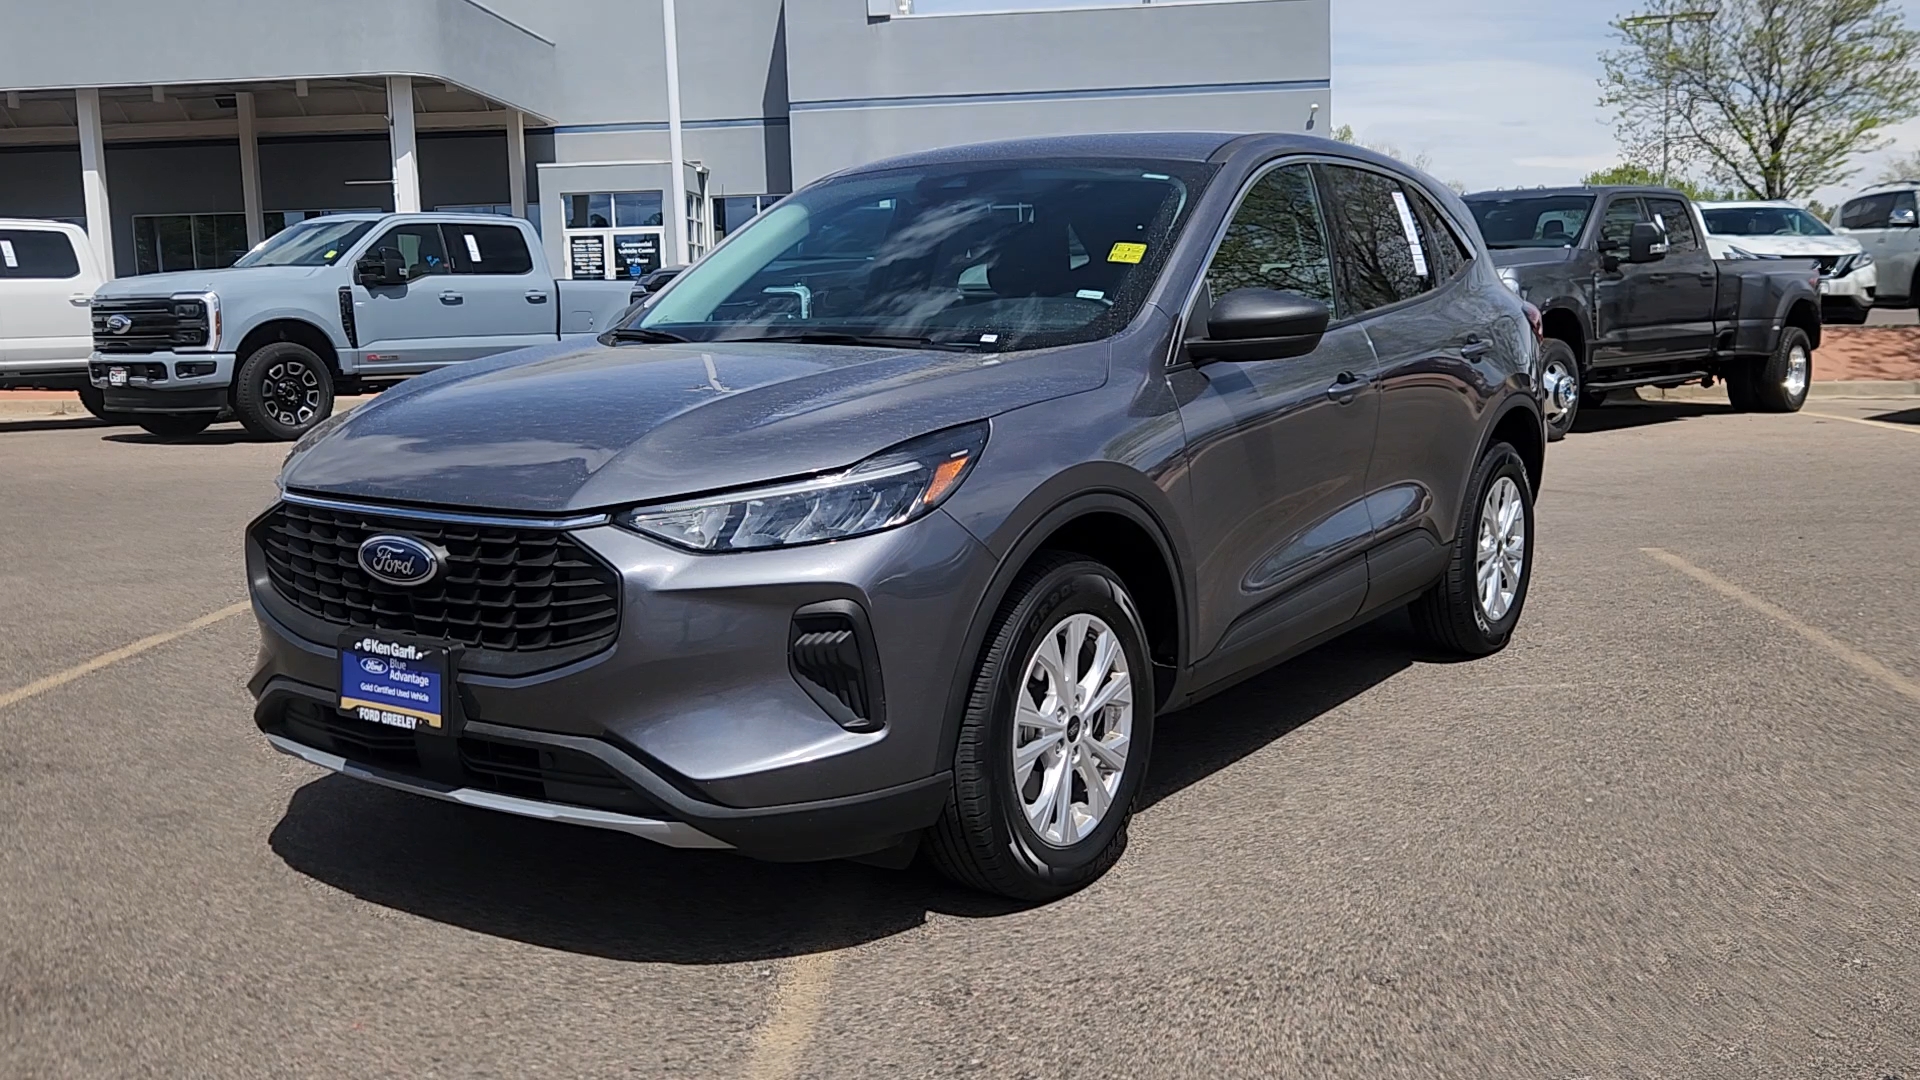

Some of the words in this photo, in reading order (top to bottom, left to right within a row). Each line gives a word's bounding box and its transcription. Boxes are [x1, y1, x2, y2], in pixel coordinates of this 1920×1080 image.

[372, 544, 415, 575] Ford
[365, 660, 384, 672] Ford
[389, 657, 407, 671] Blue
[389, 669, 430, 687] Advantage
[360, 682, 374, 692] Gold
[373, 684, 396, 696] Certified
[396, 688, 410, 699] Used
[410, 691, 430, 703] Vehicle
[359, 707, 381, 723] FORD
[381, 711, 418, 730] GREELEY
